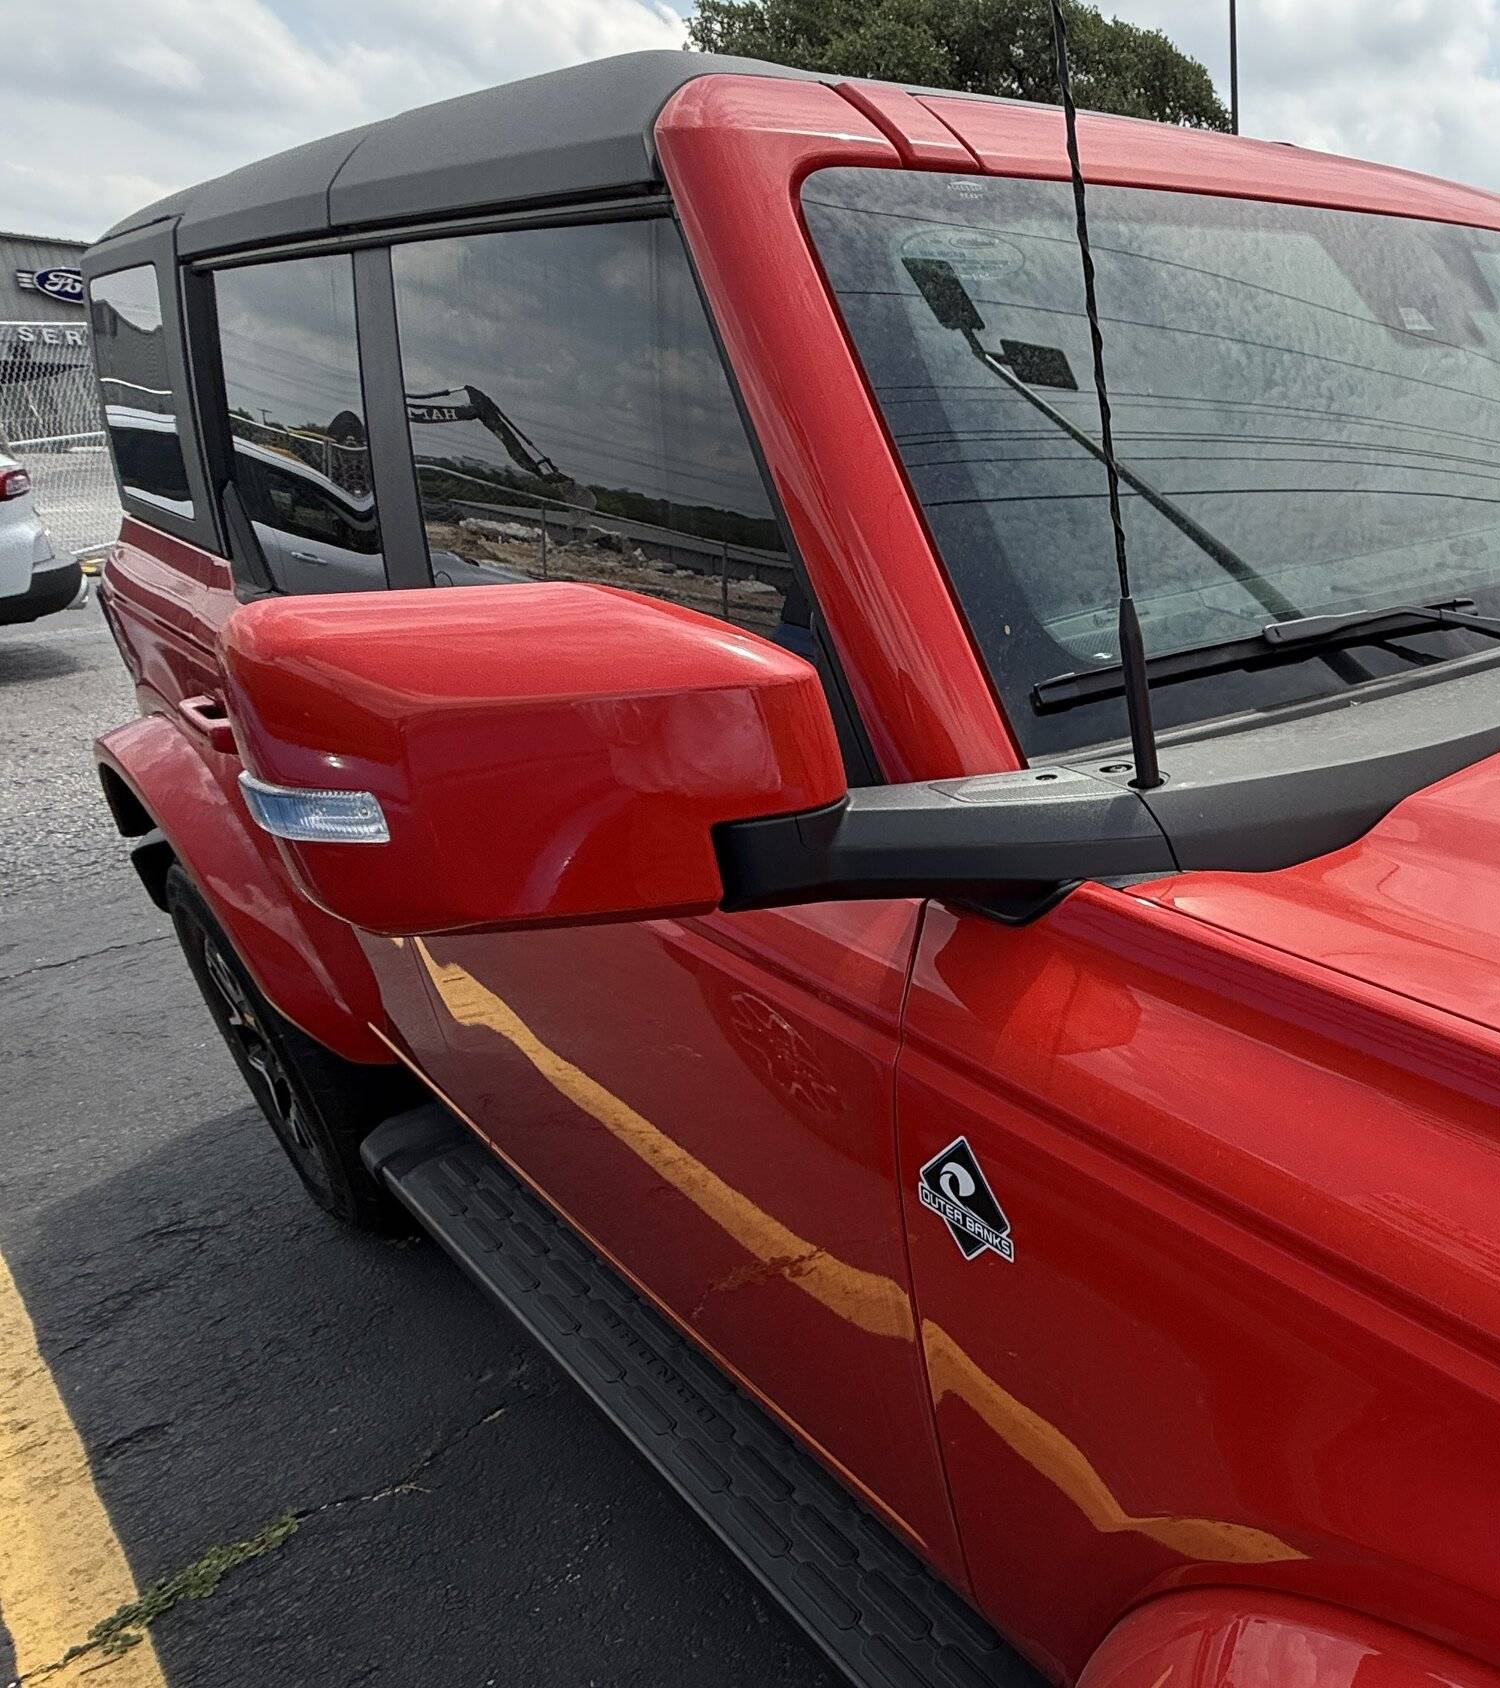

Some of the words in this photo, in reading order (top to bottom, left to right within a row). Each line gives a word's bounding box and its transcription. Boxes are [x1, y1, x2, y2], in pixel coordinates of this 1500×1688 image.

[44, 271, 84, 294] Fo
[922, 1189, 963, 1225] OUTER
[966, 1218, 1010, 1255] BANKS
